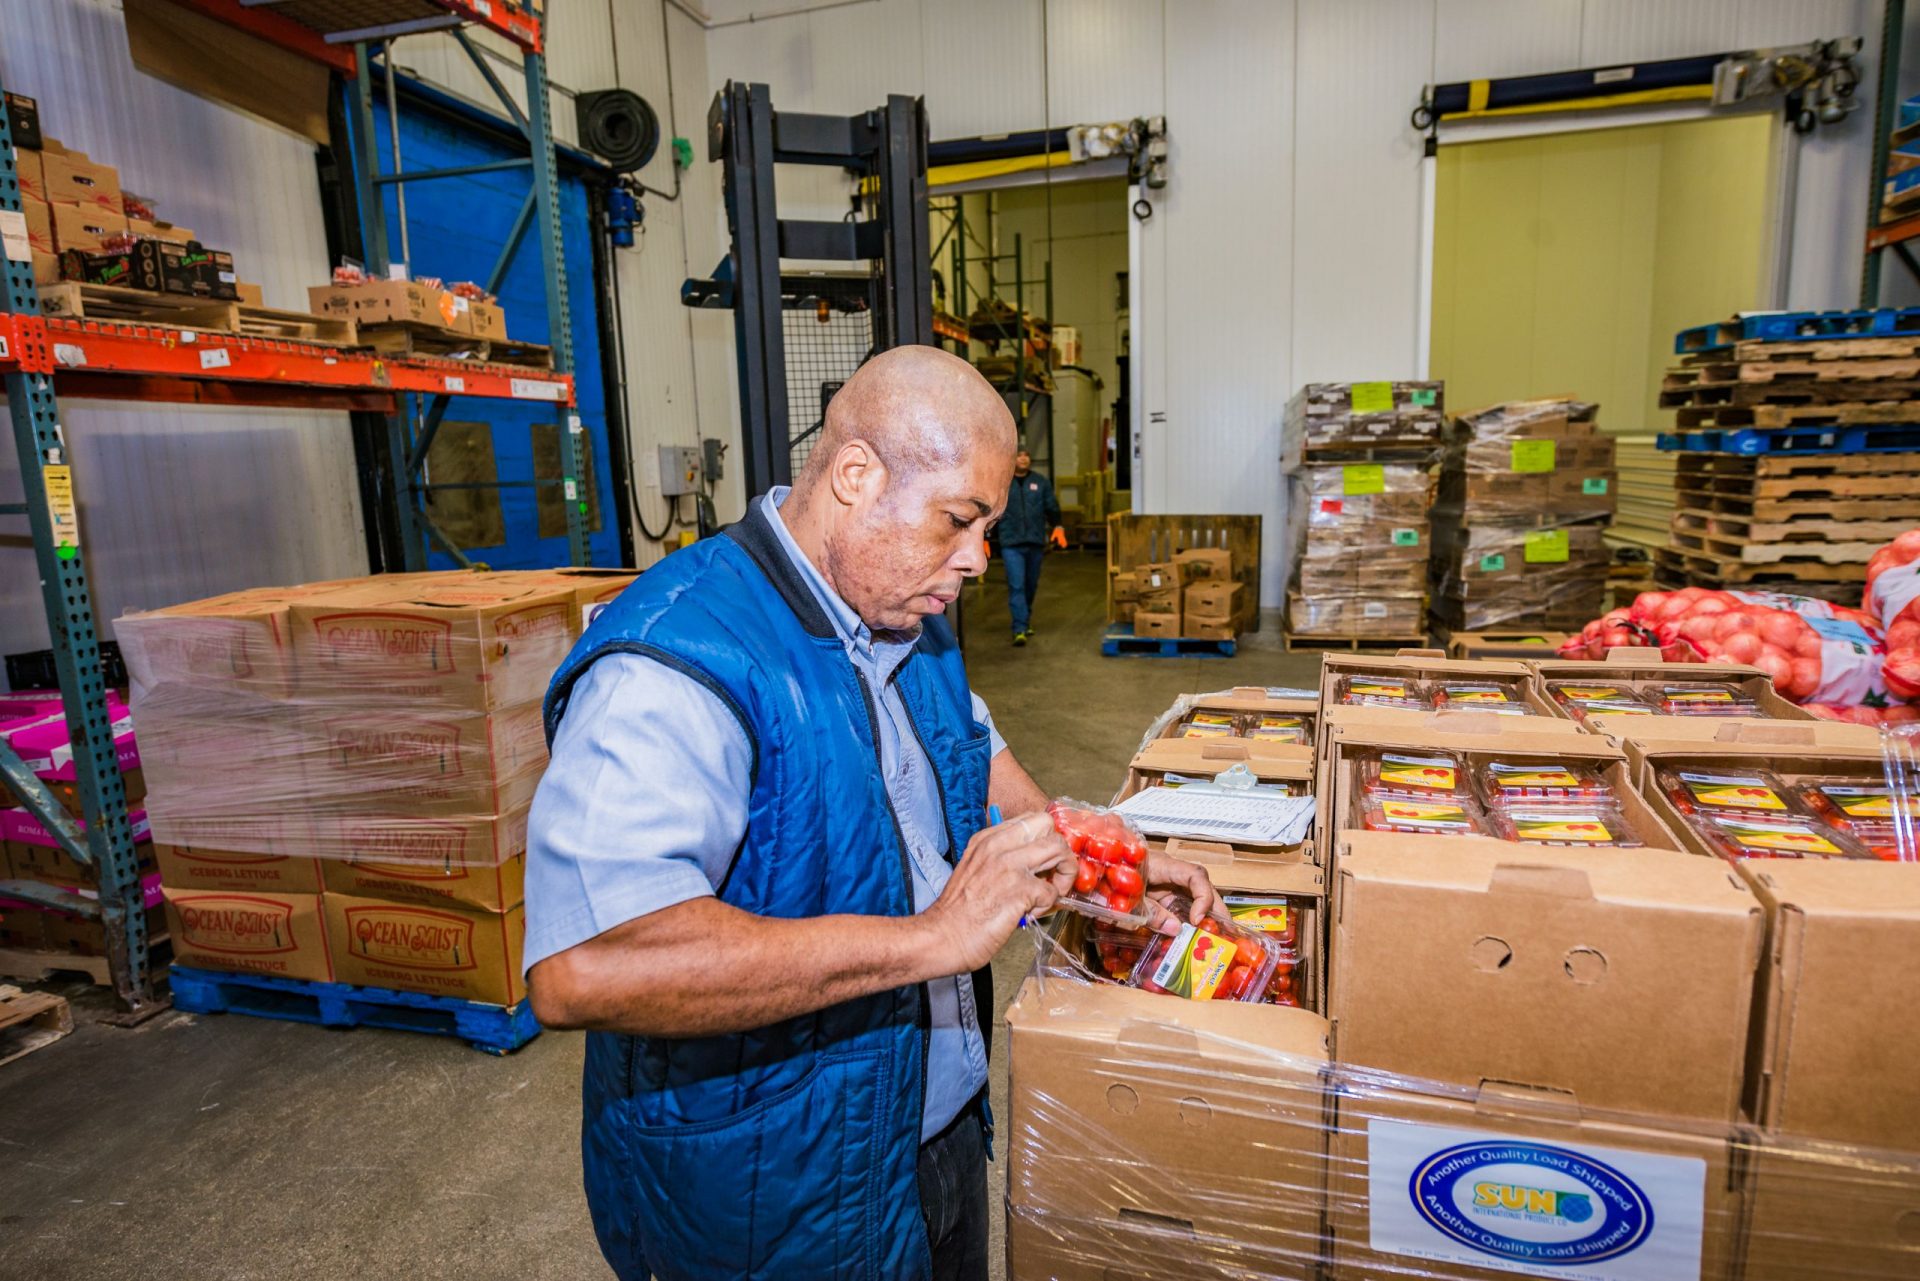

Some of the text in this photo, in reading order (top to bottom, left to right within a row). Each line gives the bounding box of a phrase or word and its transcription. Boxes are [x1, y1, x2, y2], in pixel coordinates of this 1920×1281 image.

[328, 627, 440, 656] OCEAN MIST
[189, 867, 280, 880] ICEBERG LETTUCE
[354, 877, 454, 897] ICEBERG LETTUCE
[183, 908, 282, 936] OCEAN MIST
[356, 918, 464, 951] OCEAN MIST
[240, 959, 288, 971] LETTUCE
[365, 968, 413, 981] ICEBERG
[414, 974, 466, 988] LETTUCE
[1208, 961, 1225, 986] Sweet
[1427, 1150, 1633, 1211] Another Quality Load Shipped
[1475, 1182, 1556, 1216] SUN
[1426, 1194, 1631, 1256] Another Quality Load Shipped
[1473, 1207, 1521, 1219] INTERNATIONAL
[1524, 1213, 1555, 1224] PRODUCE
